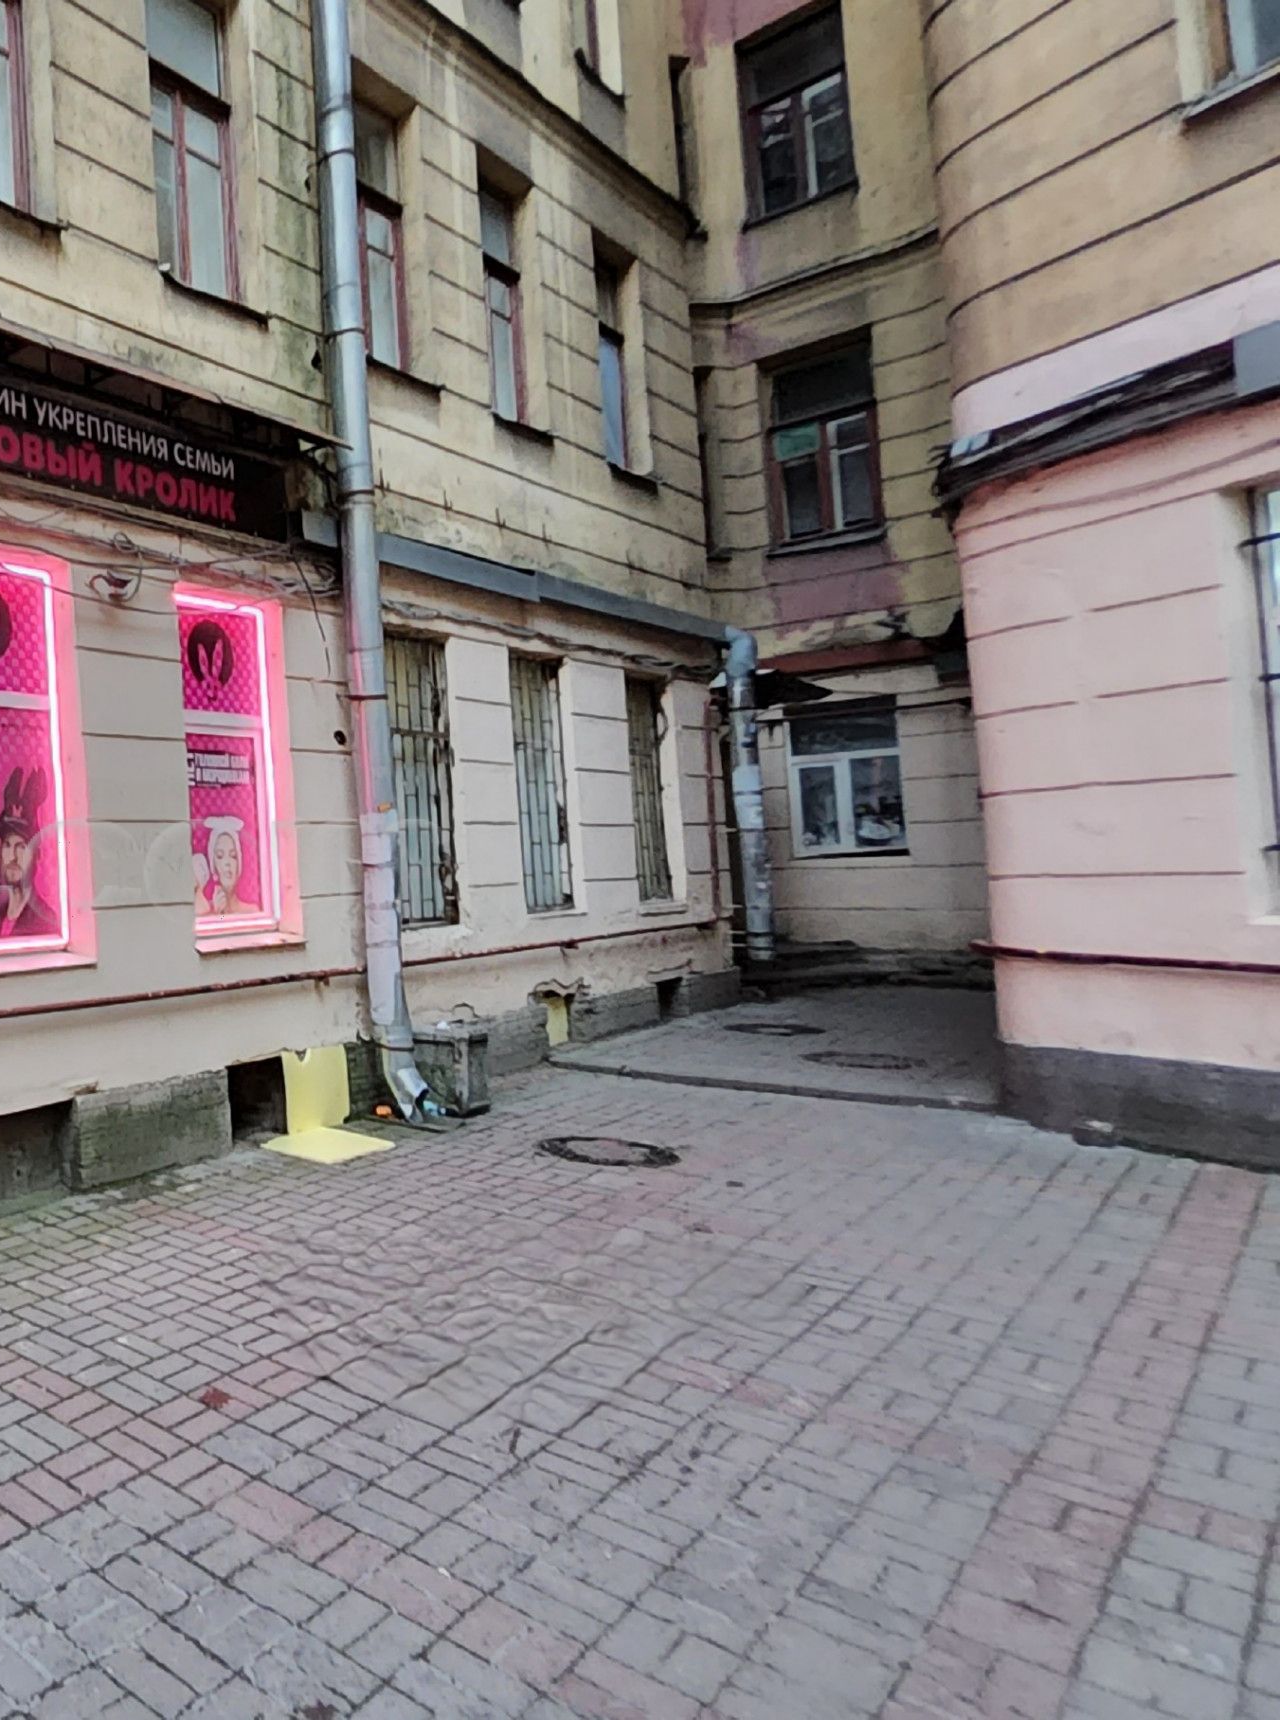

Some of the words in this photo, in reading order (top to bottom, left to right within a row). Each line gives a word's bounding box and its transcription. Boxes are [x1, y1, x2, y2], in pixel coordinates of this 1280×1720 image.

[34, 398, 168, 460] УКРЕПЛЕНИЯ
[172, 442, 236, 481] СЕМЬИ
[114, 458, 237, 522] КРОЛИК
